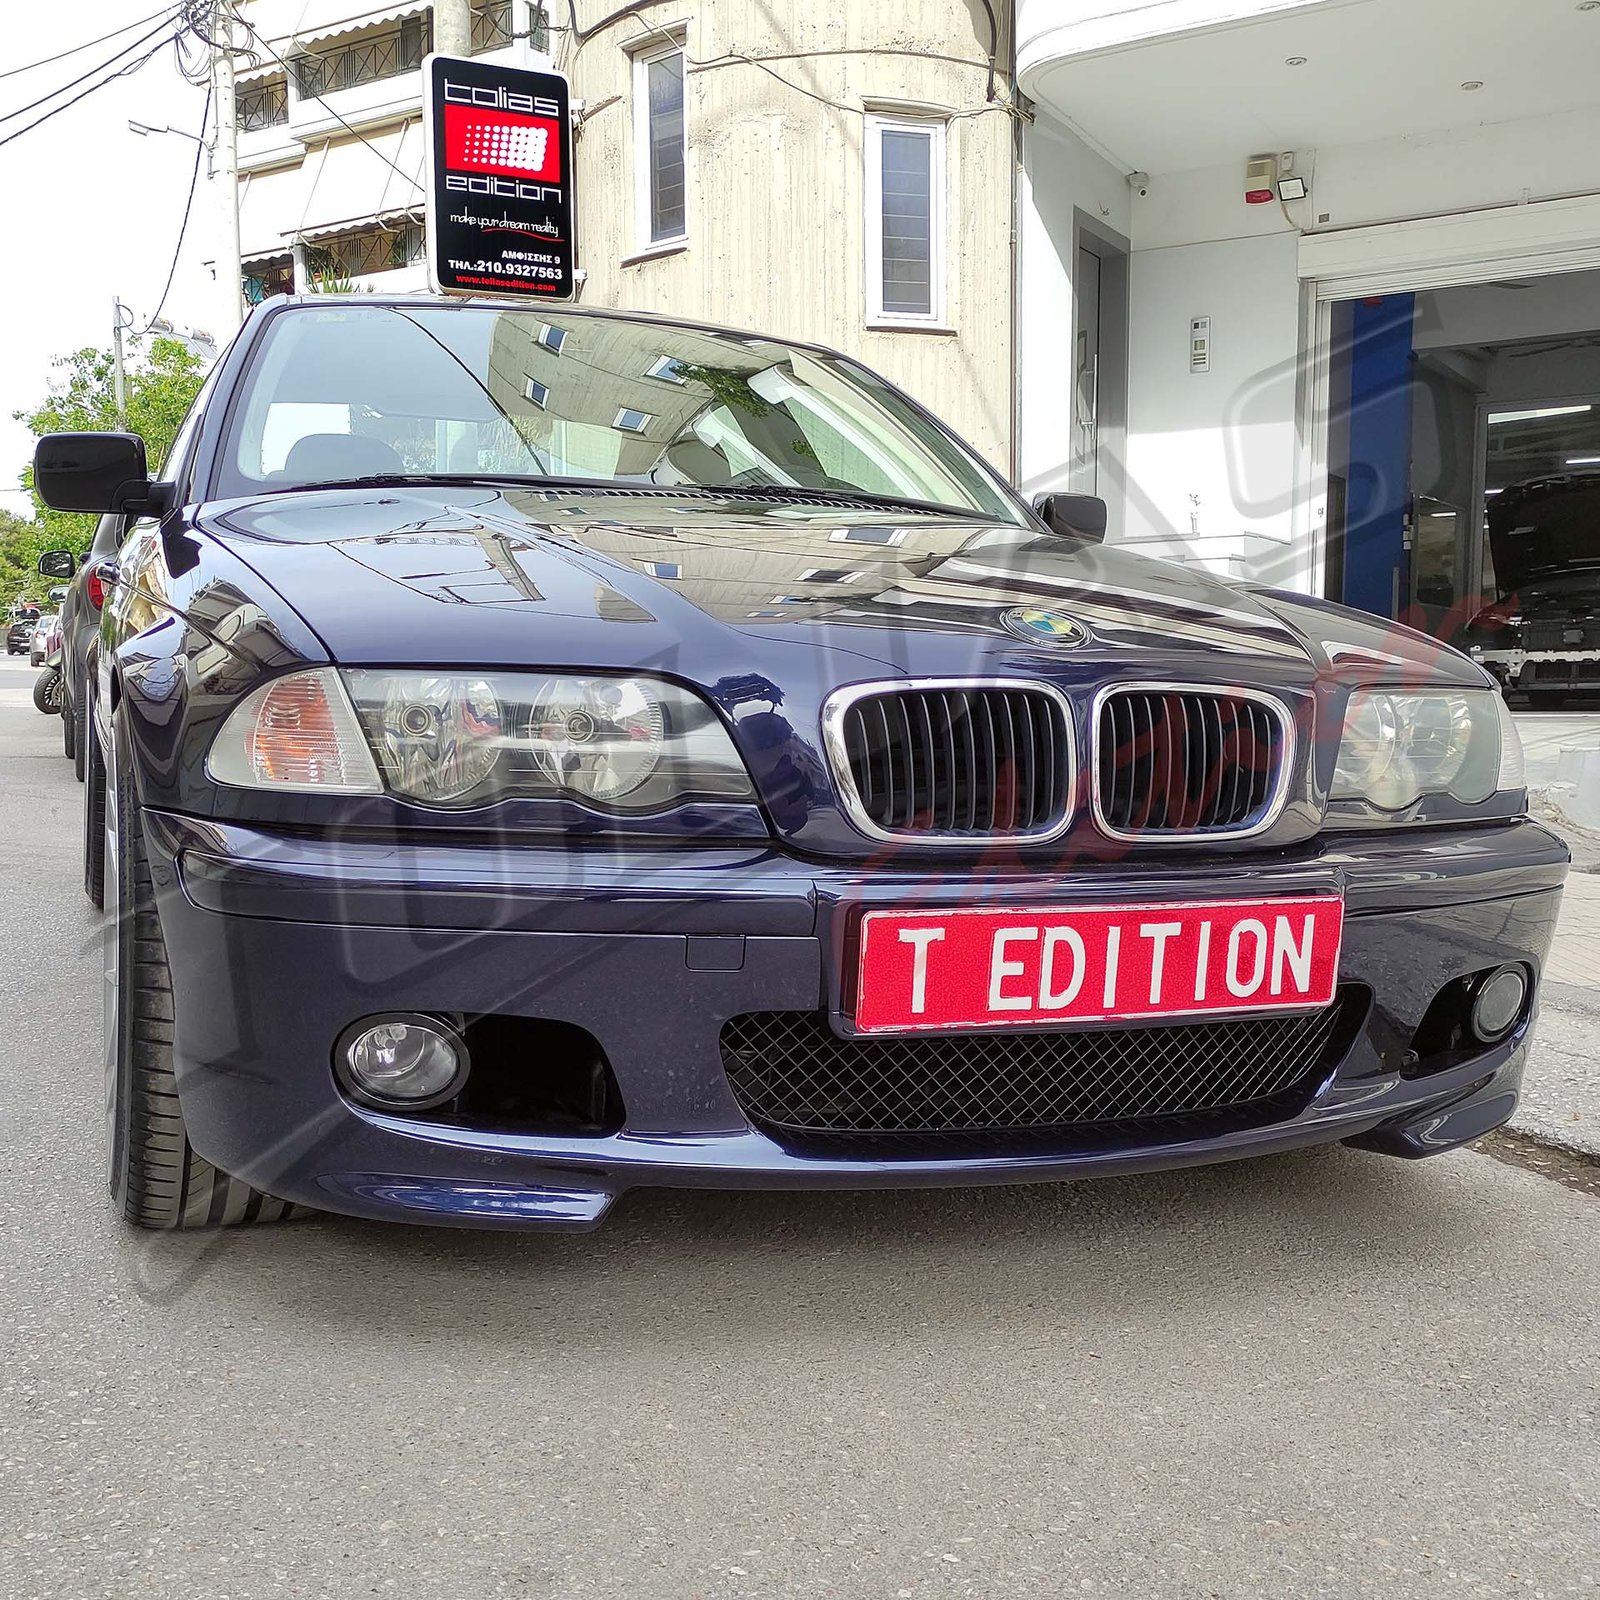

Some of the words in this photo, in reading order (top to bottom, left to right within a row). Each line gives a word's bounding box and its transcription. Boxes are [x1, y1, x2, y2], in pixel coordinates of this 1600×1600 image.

[444, 78, 559, 117] tolias
[446, 176, 561, 204] edition
[450, 206, 477, 225] make
[477, 217, 499, 229] your
[499, 211, 530, 231] dream
[531, 216, 559, 237] reality
[501, 250, 552, 264] ΑΜΦΙΣΣΗΣ
[554, 257, 561, 265] 9
[456, 275, 556, 291] www.toliasedition.com
[897, 927, 946, 1014] T
[988, 914, 1316, 1011] EDITION
